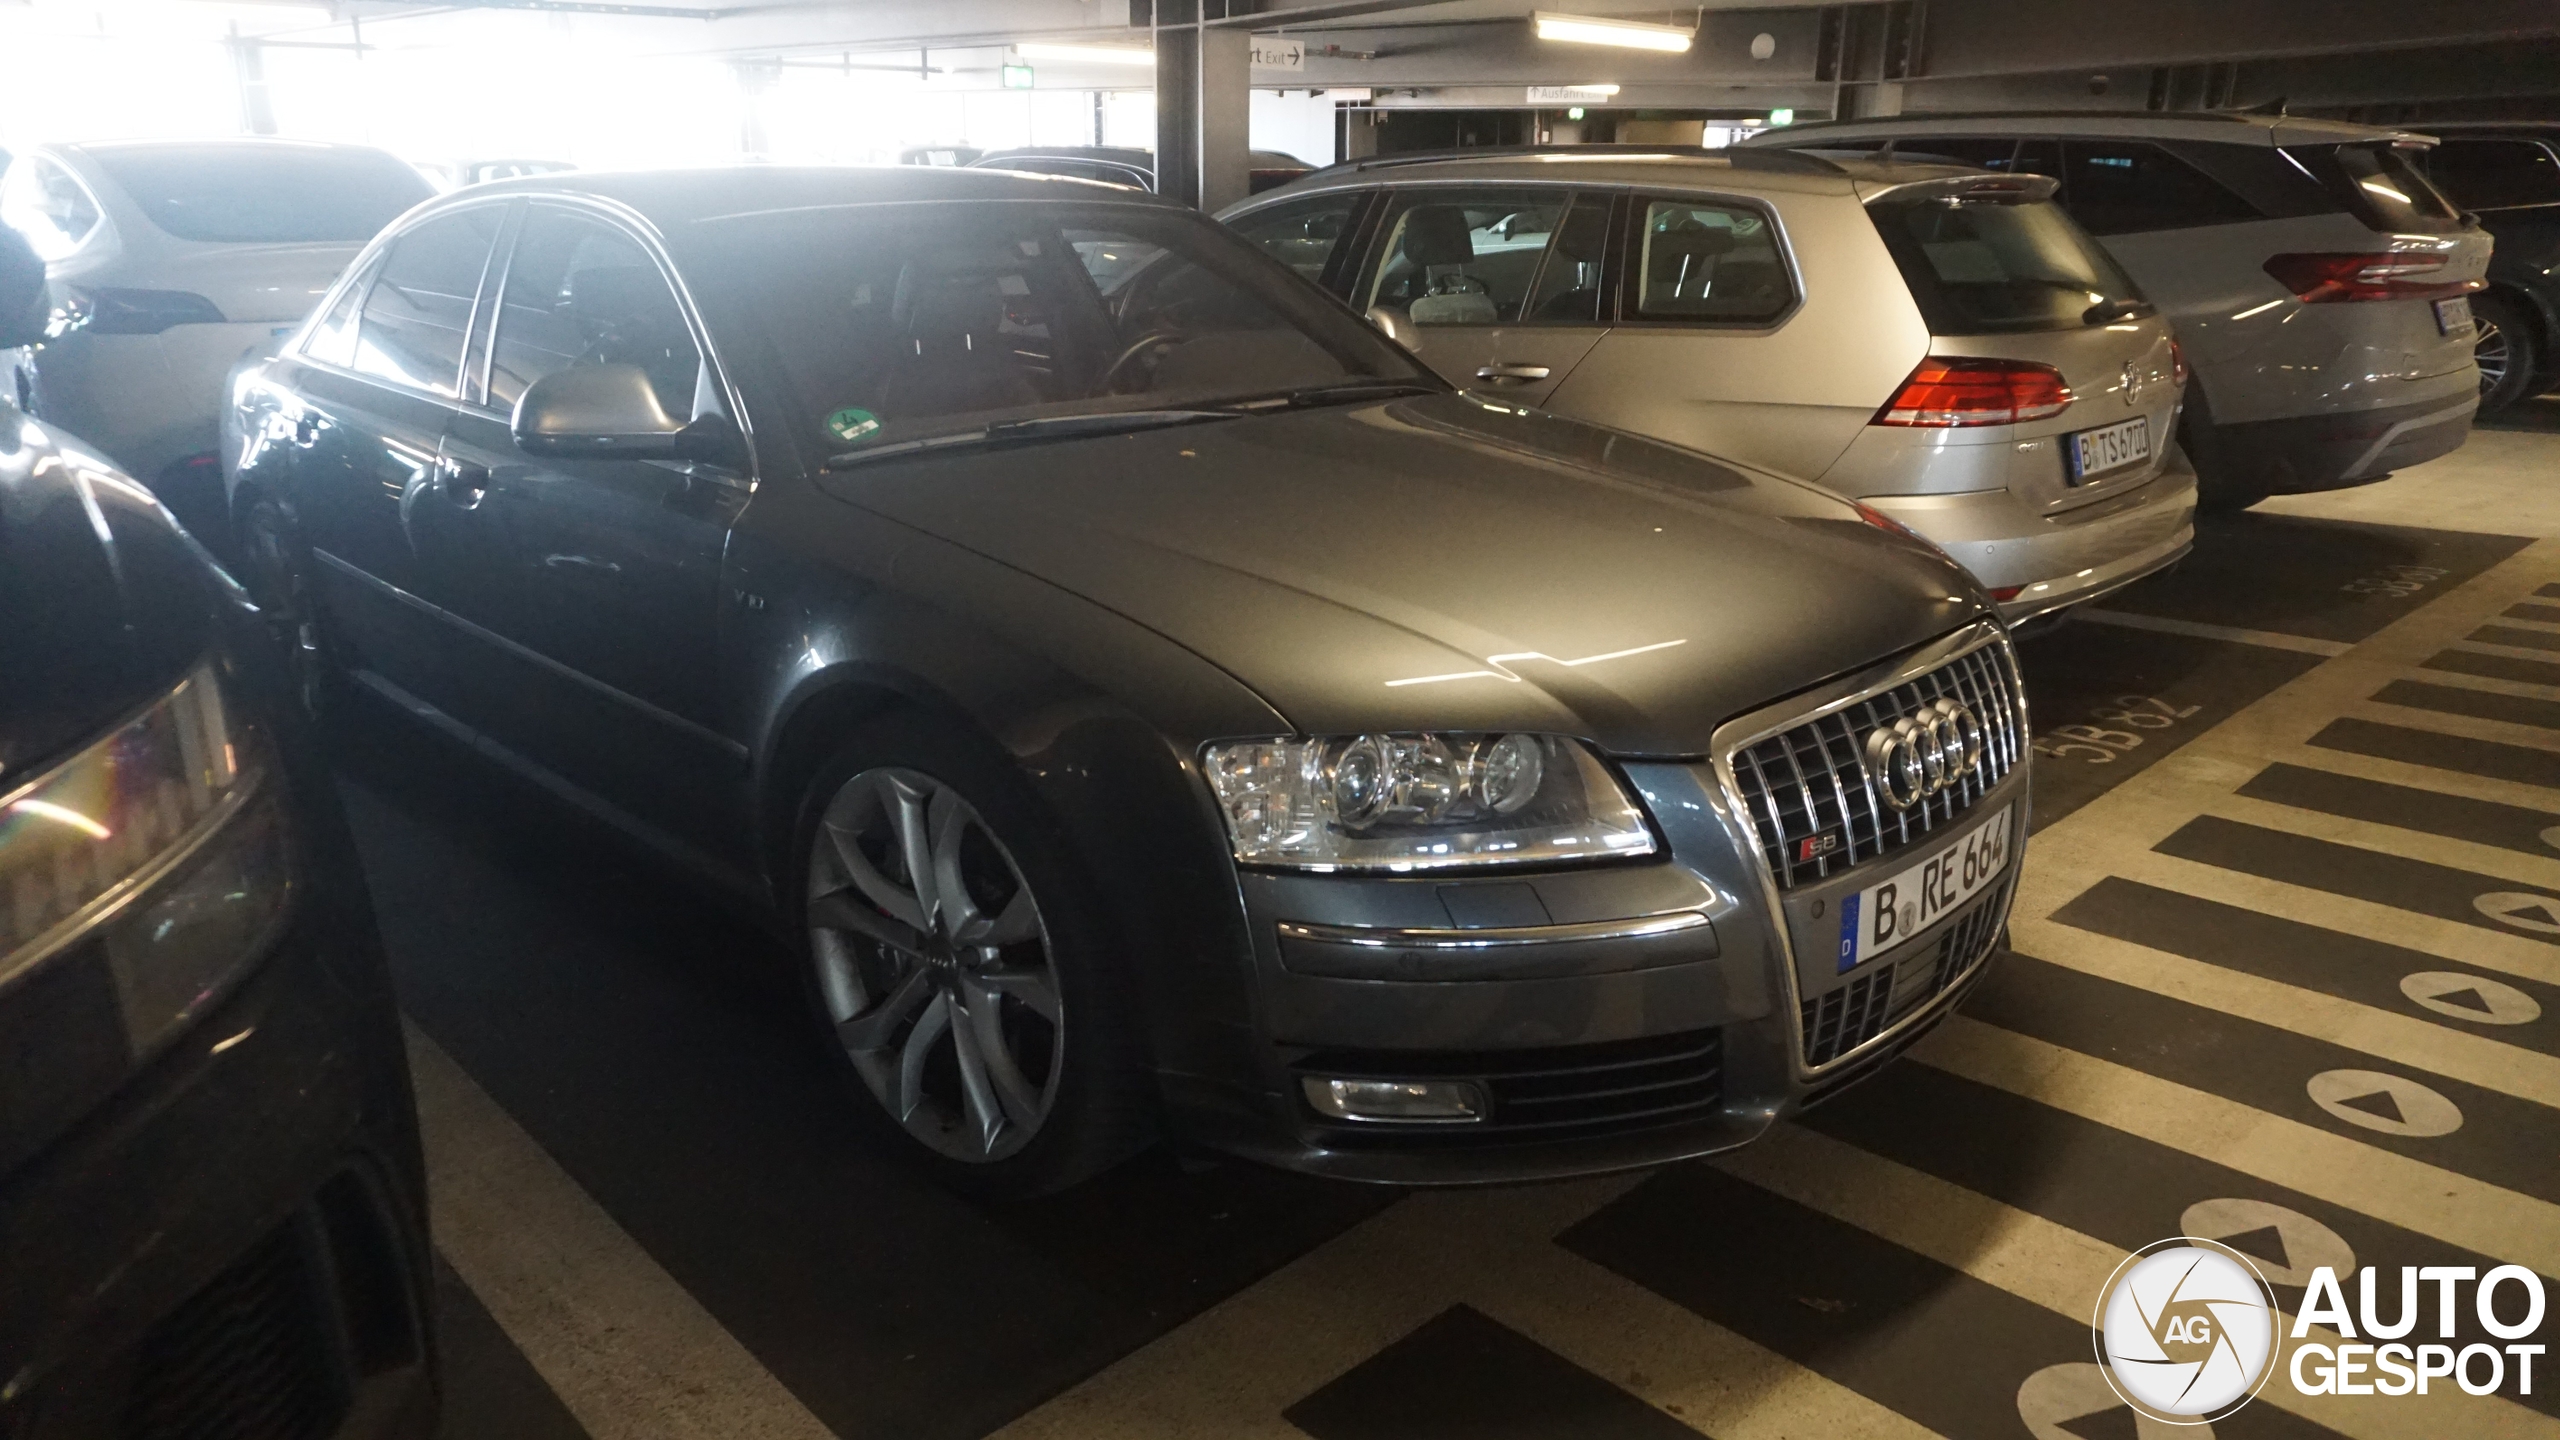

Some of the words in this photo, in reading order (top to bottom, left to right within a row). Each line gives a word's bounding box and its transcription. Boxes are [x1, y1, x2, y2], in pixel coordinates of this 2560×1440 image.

[1266, 50, 1285, 64] Exit
[2081, 438, 2092, 470] B
[2099, 431, 2118, 464] TS
[2032, 695, 2202, 763] 5B82
[1810, 834, 1836, 856] S8
[1874, 882, 1897, 947] B
[1921, 846, 1958, 922] RE
[1963, 812, 2004, 891] 664
[1842, 939, 1851, 957] D
